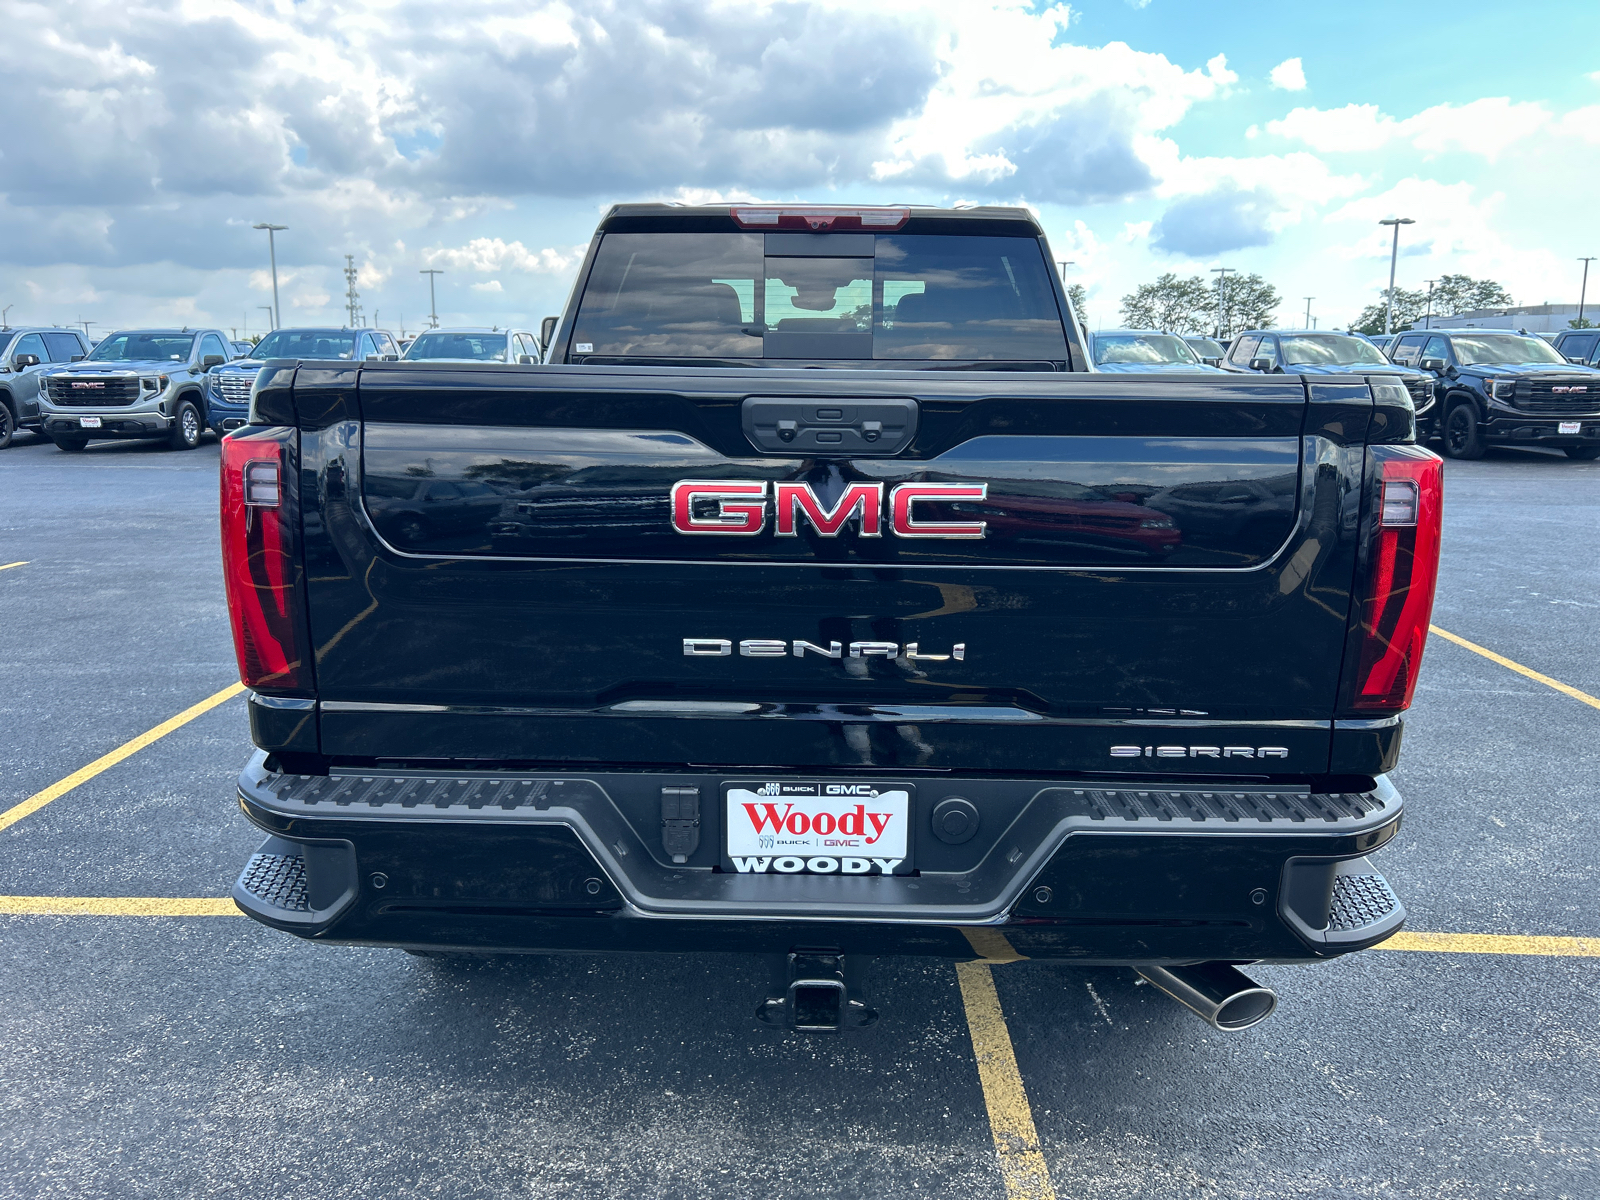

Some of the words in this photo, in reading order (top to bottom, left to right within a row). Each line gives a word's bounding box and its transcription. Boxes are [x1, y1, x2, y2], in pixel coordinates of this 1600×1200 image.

[1552, 386, 1588, 394] GMC
[670, 479, 988, 540] GMC
[683, 637, 966, 662] DENALI
[1109, 745, 1289, 759] SIERRA
[826, 784, 871, 795] GMC
[741, 802, 893, 844] Woody
[824, 839, 860, 847] GMC
[731, 857, 903, 875] WOODY
